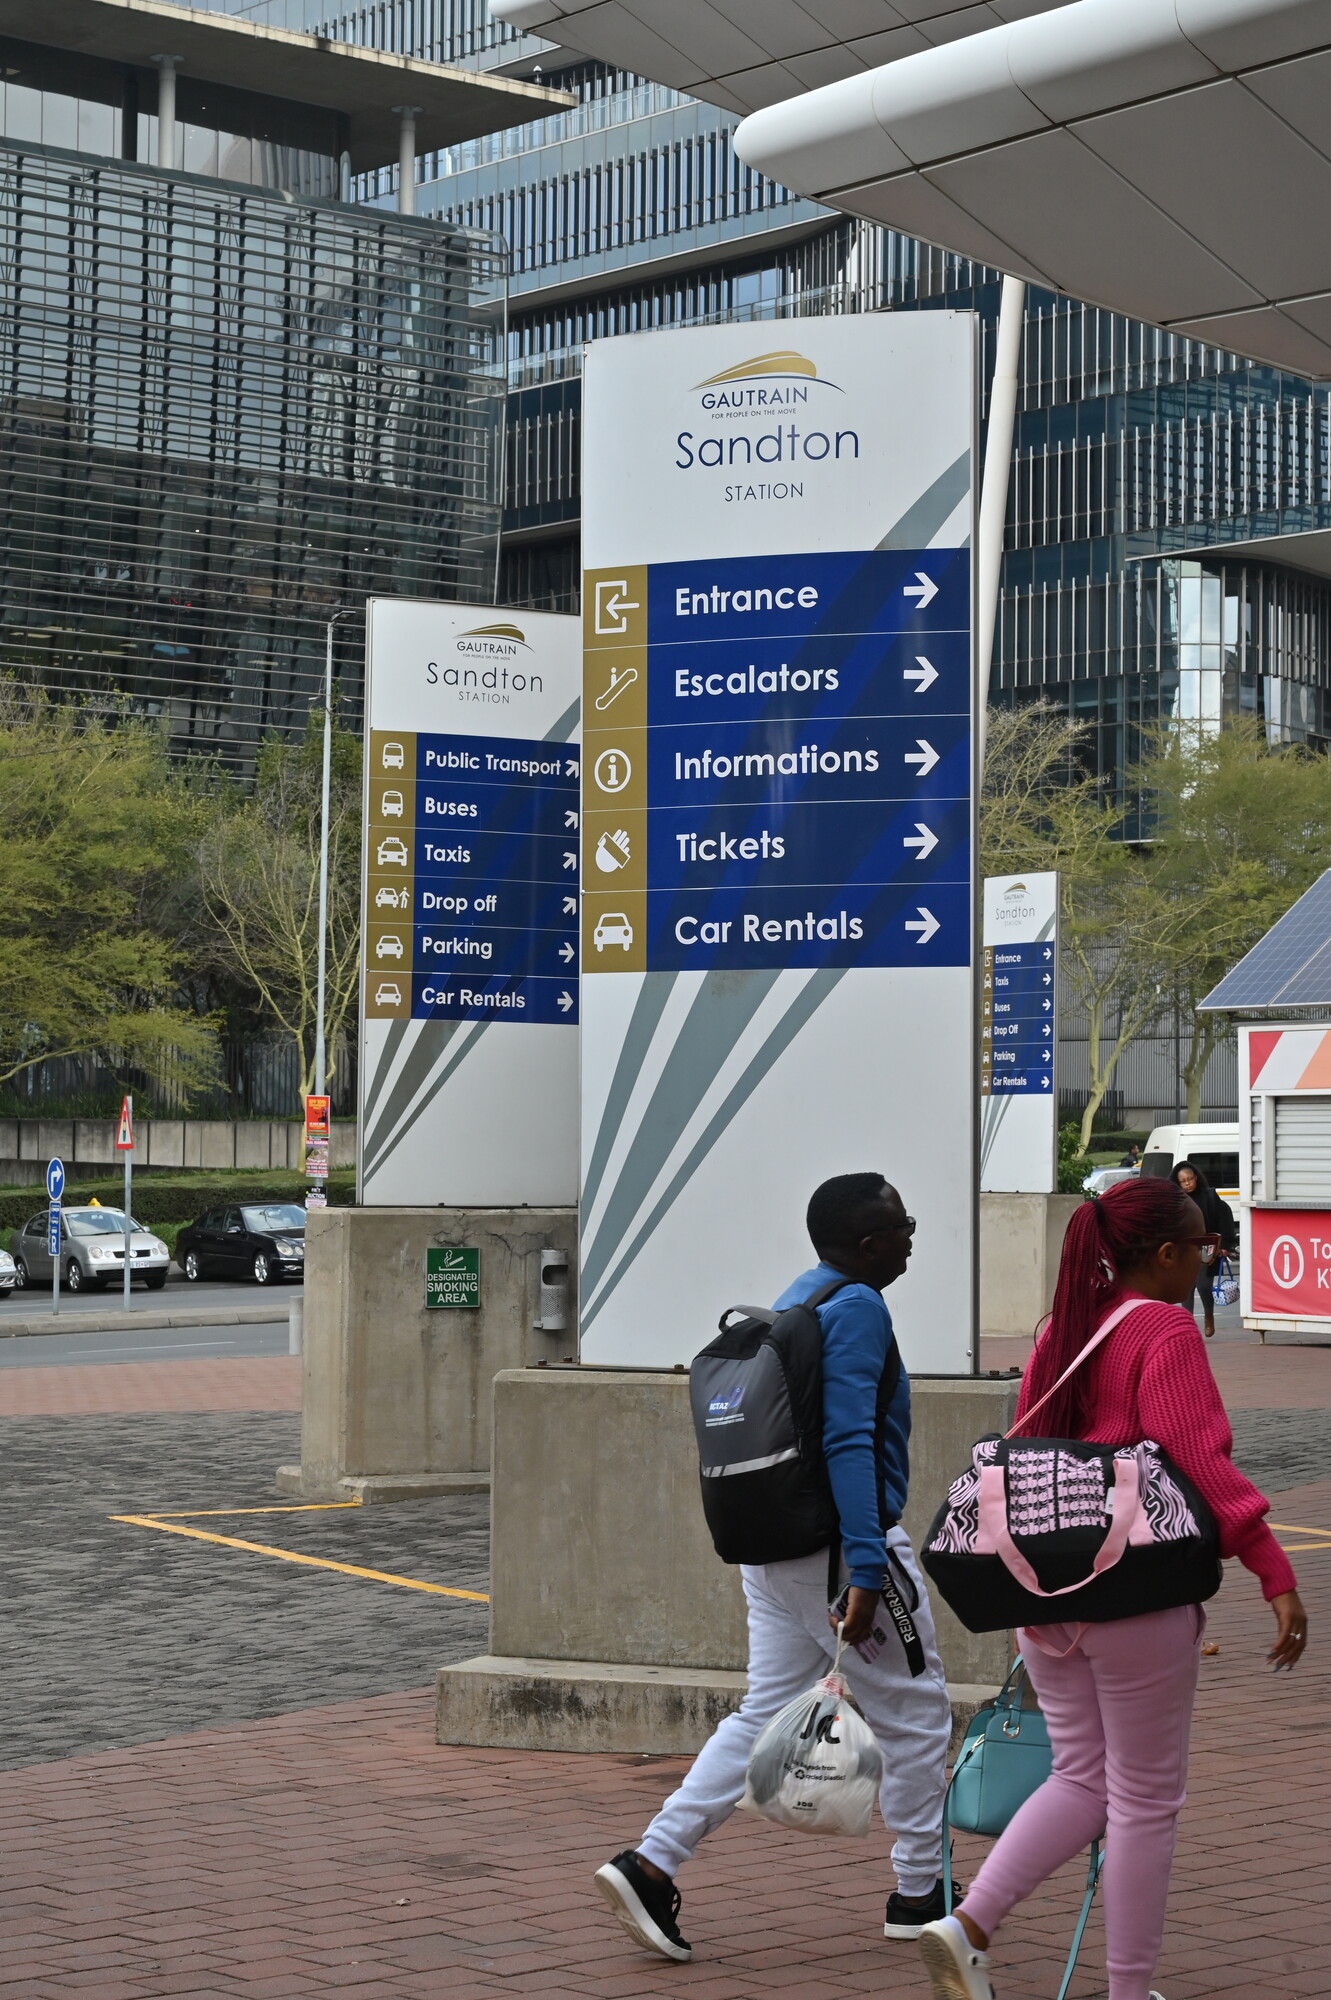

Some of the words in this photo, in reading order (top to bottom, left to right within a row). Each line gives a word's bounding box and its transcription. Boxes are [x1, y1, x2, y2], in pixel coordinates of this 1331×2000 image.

[701, 386, 807, 409] GAUTRAIN
[676, 424, 859, 469] Sandton
[725, 482, 803, 502] STATION
[676, 585, 818, 616] Entrance
[457, 641, 516, 655] GAUTRAIN
[426, 662, 542, 692] Sandton
[675, 663, 839, 697] Escalators
[459, 691, 509, 703] STATION
[425, 750, 480, 769] Public
[485, 754, 561, 777] Transport
[675, 744, 879, 780] Informations
[425, 797, 478, 817] Buses
[424, 844, 471, 863] Taxis
[676, 830, 785, 861] Tickets
[423, 892, 468, 914] Drop
[474, 894, 497, 912] off
[995, 907, 1035, 920] Sandton
[675, 916, 732, 945] Car
[743, 911, 864, 942] Rentals
[422, 936, 492, 960] Parking
[995, 954, 1021, 964] Entrance
[995, 976, 1009, 986] Taxis
[422, 987, 454, 1005] Car
[460, 989, 525, 1008] Rentals
[994, 1003, 1010, 1012] Buses
[994, 1026, 1007, 1036] Drop
[1008, 1024, 1018, 1034] Off
[994, 1051, 1015, 1062] Parking
[993, 1077, 1002, 1086] Car
[1003, 1076, 1027, 1086] Rentals
[427, 1273, 477, 1281] DESIGNATED
[427, 1282, 478, 1292] SMOKING
[1317, 1268, 1331, 1288] K
[437, 1293, 467, 1303] AREA
[709, 1402, 729, 1410] ICTAZ
[1008, 1461, 1054, 1475] rebel
[1009, 1472, 1054, 1490] rebel
[1057, 1470, 1104, 1482] heart
[1009, 1486, 1054, 1505] rebel
[1057, 1484, 1105, 1498] heart
[1010, 1502, 1055, 1521] rebel
[1058, 1500, 1106, 1514] heart
[1010, 1518, 1056, 1536] rebel
[1059, 1515, 1107, 1529] heart
[882, 1574, 916, 1643] REDIBRAND
